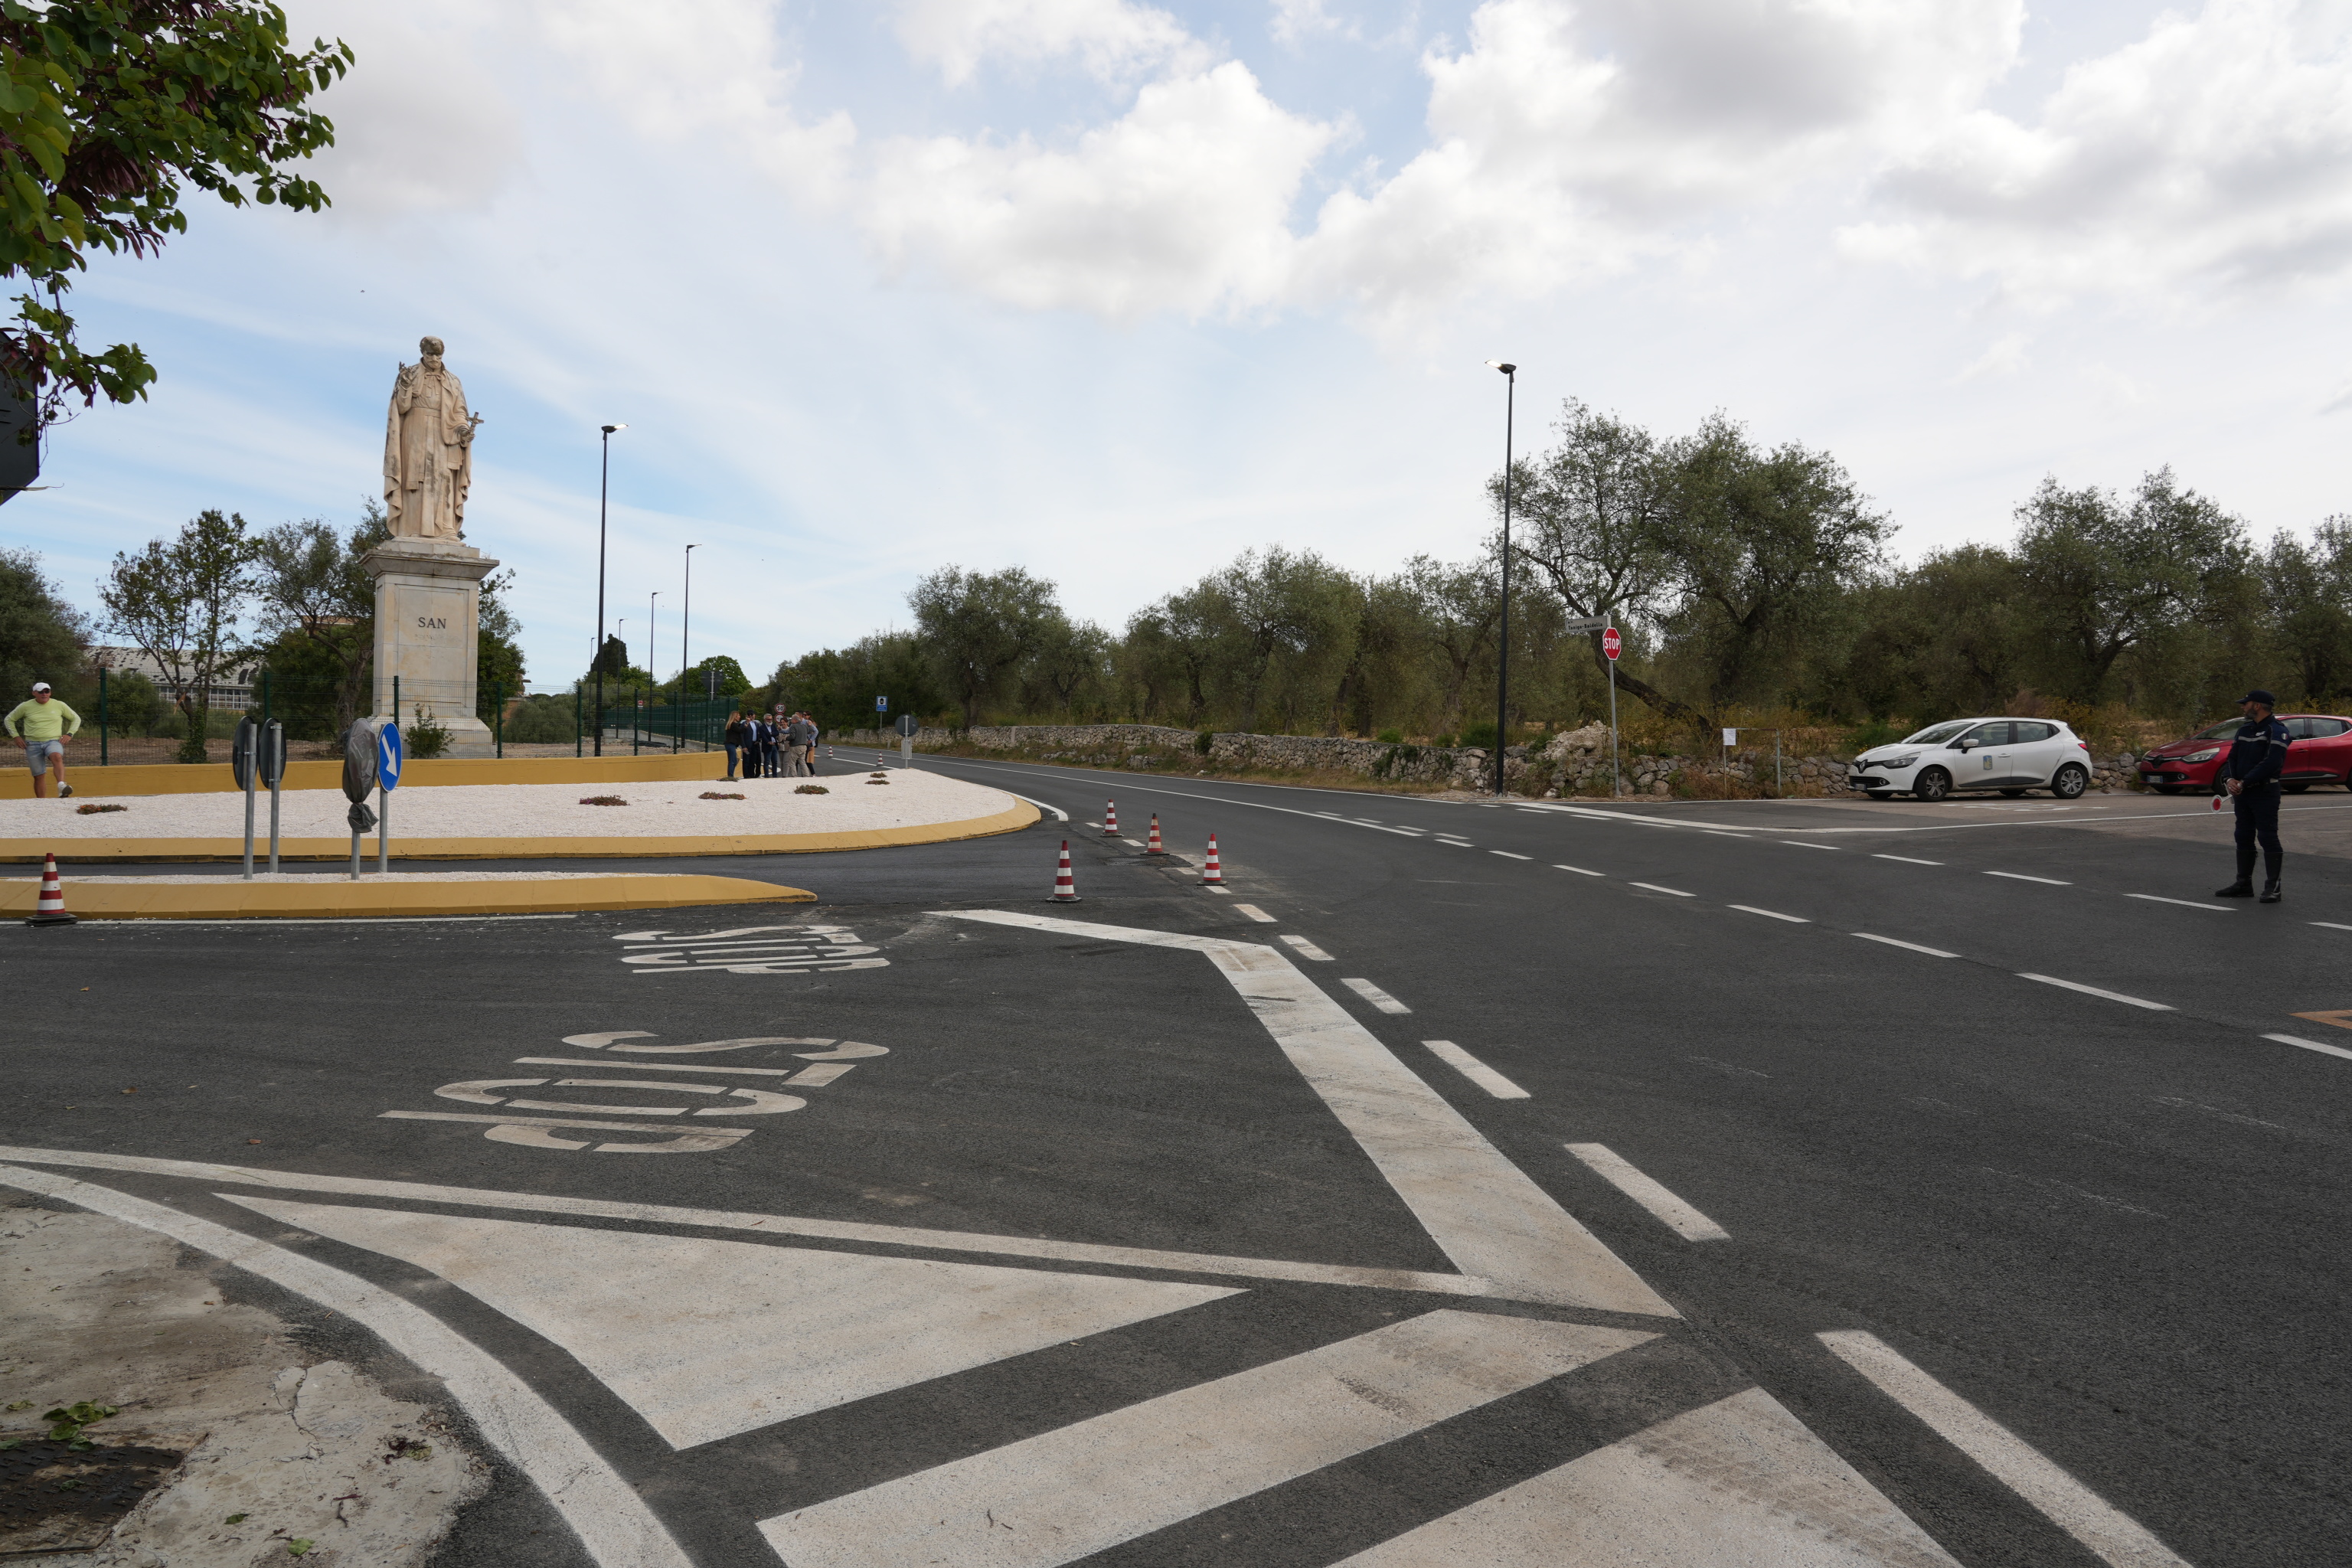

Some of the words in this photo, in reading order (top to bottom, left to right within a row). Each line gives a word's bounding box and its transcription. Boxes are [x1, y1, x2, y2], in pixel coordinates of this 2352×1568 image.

[418, 616, 446, 629] SAN
[1604, 637, 1620, 650] STOP
[612, 925, 890, 973] STOP
[376, 1031, 890, 1153] STOP
